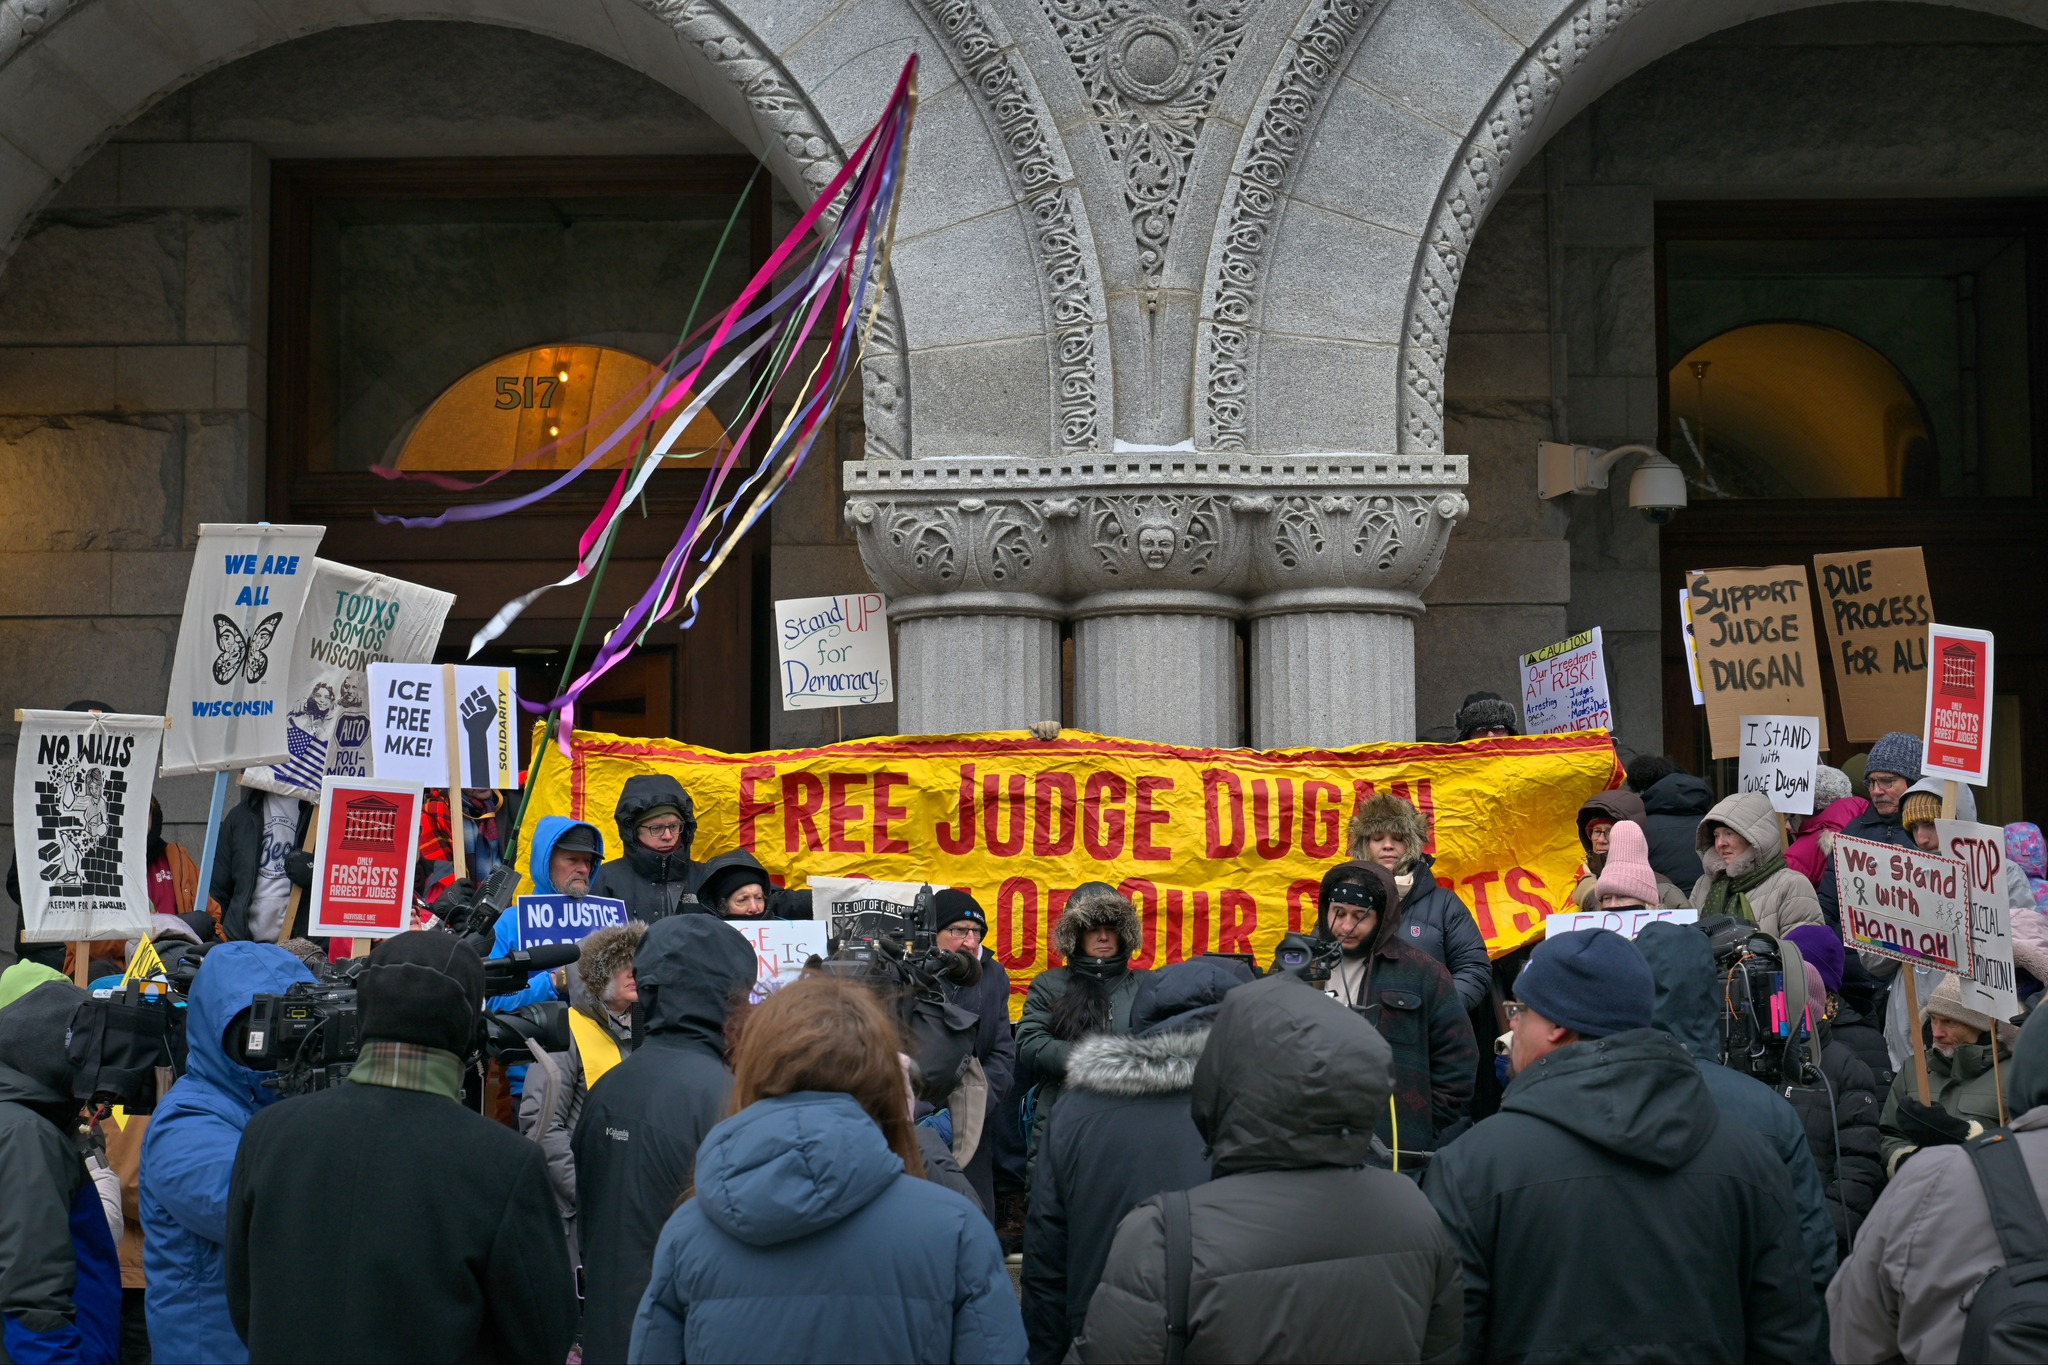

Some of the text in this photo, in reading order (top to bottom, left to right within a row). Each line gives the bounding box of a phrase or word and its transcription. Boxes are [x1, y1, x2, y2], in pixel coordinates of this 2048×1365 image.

[495, 376, 560, 410] 517
[224, 554, 300, 575] WE ARE
[1823, 560, 1873, 599] DUE
[235, 586, 269, 606] ALL
[1691, 576, 1803, 614] SUPPORT
[336, 590, 400, 631] TODXS
[785, 594, 882, 640] Stand UP
[1832, 594, 1929, 636] PROCESS
[330, 617, 386, 652] SOMOS
[1709, 612, 1799, 647] JUDGE
[818, 639, 853, 665] for
[1539, 632, 1588, 661] CAUTION
[1841, 640, 1881, 675] FOR
[1529, 650, 1597, 682] Our Freedoms
[1709, 651, 1804, 691] DUGAN
[388, 679, 432, 702] ICE
[782, 660, 879, 703] Democracy
[1526, 661, 1594, 701] AT RISK!
[1570, 685, 1594, 699] Judges
[192, 700, 274, 717] WISCONSIN
[1526, 697, 1558, 715] Arresting
[1571, 696, 1594, 709] Mayors
[1951, 702, 1962, 710] ONLY
[386, 705, 431, 733] FREE
[498, 689, 507, 771] SOLIDARITY
[1529, 712, 1544, 722] DACA
[1935, 708, 1979, 733] FASCISTS
[340, 718, 366, 744] ALTO
[1746, 723, 1758, 746] I
[1934, 728, 1978, 744] ARREST JUDGES
[38, 734, 135, 767] NO WALLS
[335, 750, 366, 766] POLI-
[384, 735, 433, 758] MKE!
[1760, 749, 1780, 764] with
[739, 765, 909, 853] FREE
[935, 763, 1175, 861] JUDGE
[357, 857, 373, 866] ONLY
[1843, 846, 1957, 899] We Stand
[330, 864, 399, 887] FASCISTS
[330, 884, 397, 899] ARREST JUDGES
[1876, 883, 1920, 917] with
[48, 901, 76, 911] FREEDOM
[527, 904, 554, 928] NO
[853, 901, 867, 912] OUT
[869, 900, 879, 910] OF
[1969, 901, 2004, 937] DICIAL
[1117, 877, 1258, 970] OUR
[782, 943, 810, 964] IS
